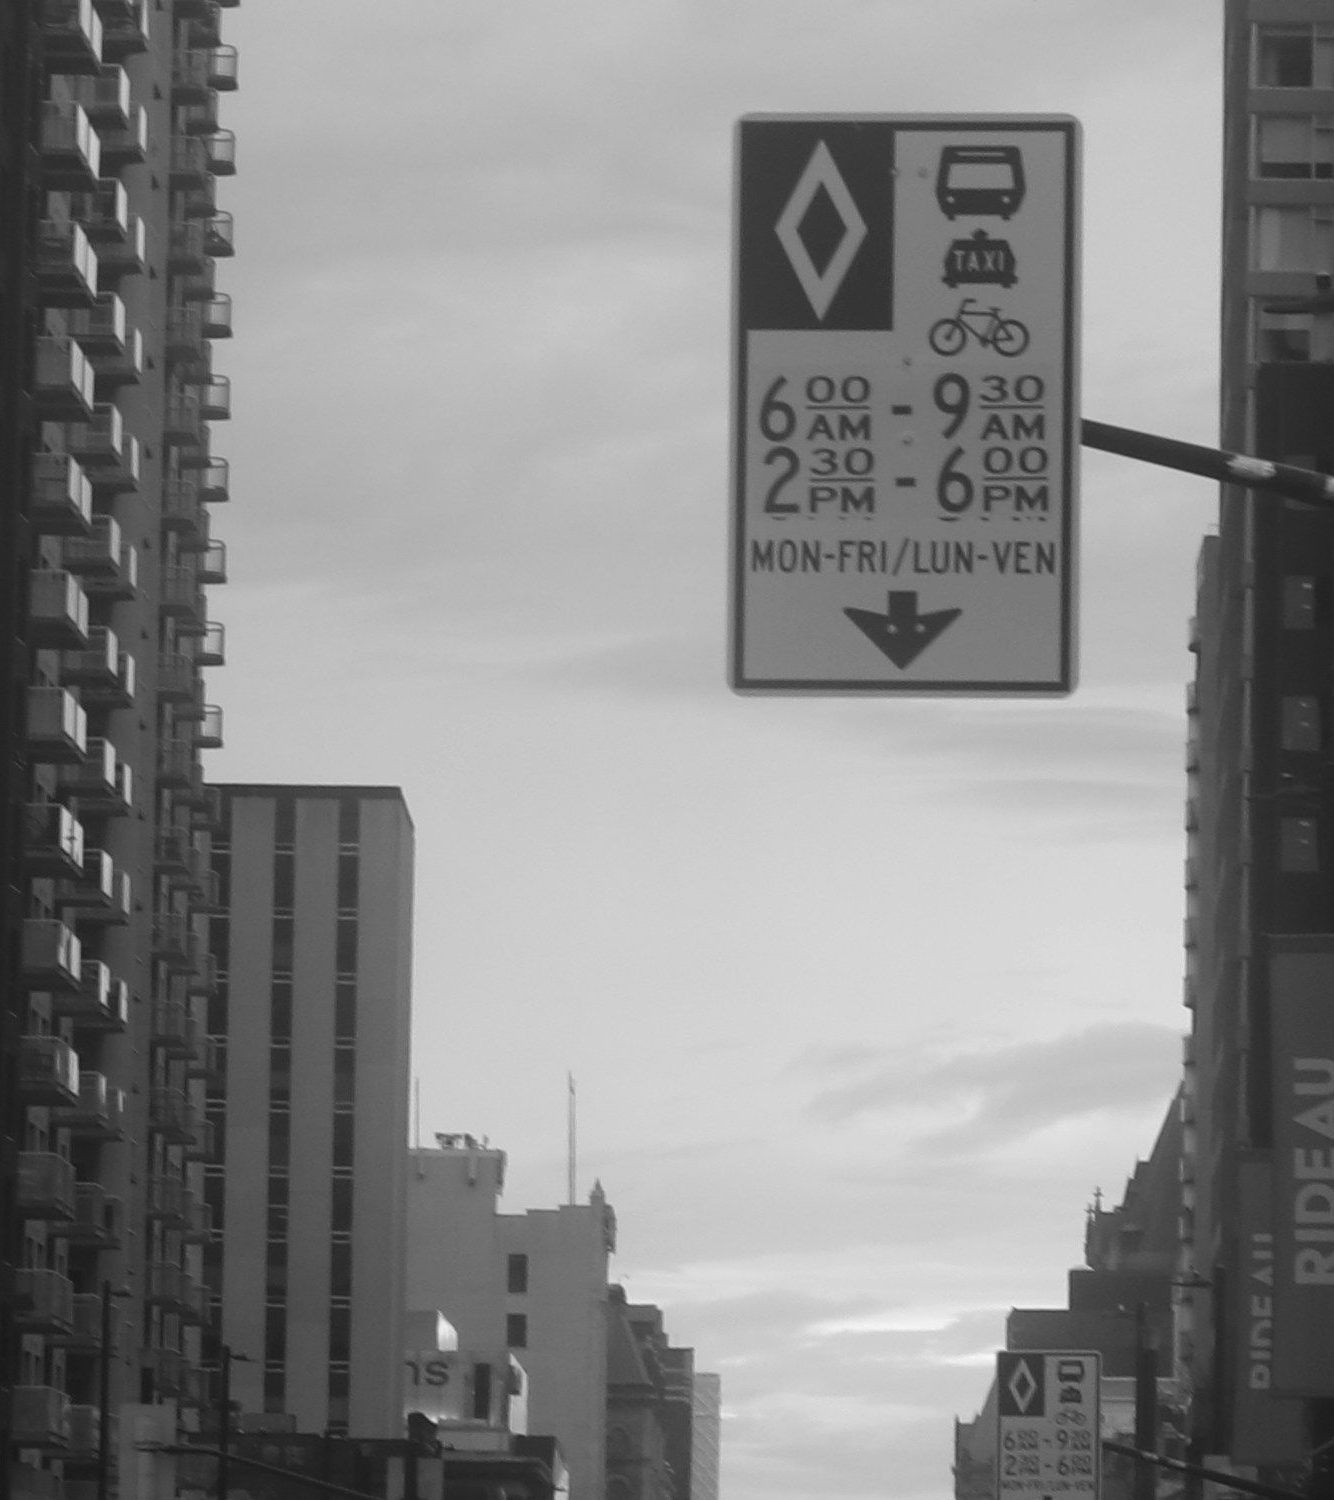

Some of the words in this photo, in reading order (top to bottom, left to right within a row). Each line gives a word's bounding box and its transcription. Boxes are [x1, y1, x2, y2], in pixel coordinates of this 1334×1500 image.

[953, 247, 1007, 274] TAXI
[805, 375, 870, 403] 00
[979, 374, 1045, 402] 30
[758, 374, 797, 442] 6
[933, 372, 970, 440] 9
[806, 414, 871, 441] AM
[980, 414, 1045, 441] AM
[808, 448, 875, 476] 30
[983, 447, 1048, 475] 00
[760, 445, 800, 515] 2
[937, 447, 974, 513] 6
[808, 485, 876, 513] PM
[983, 485, 1049, 513] PM
[749, 537, 1057, 577] MON-FRI/LUN-VEN
